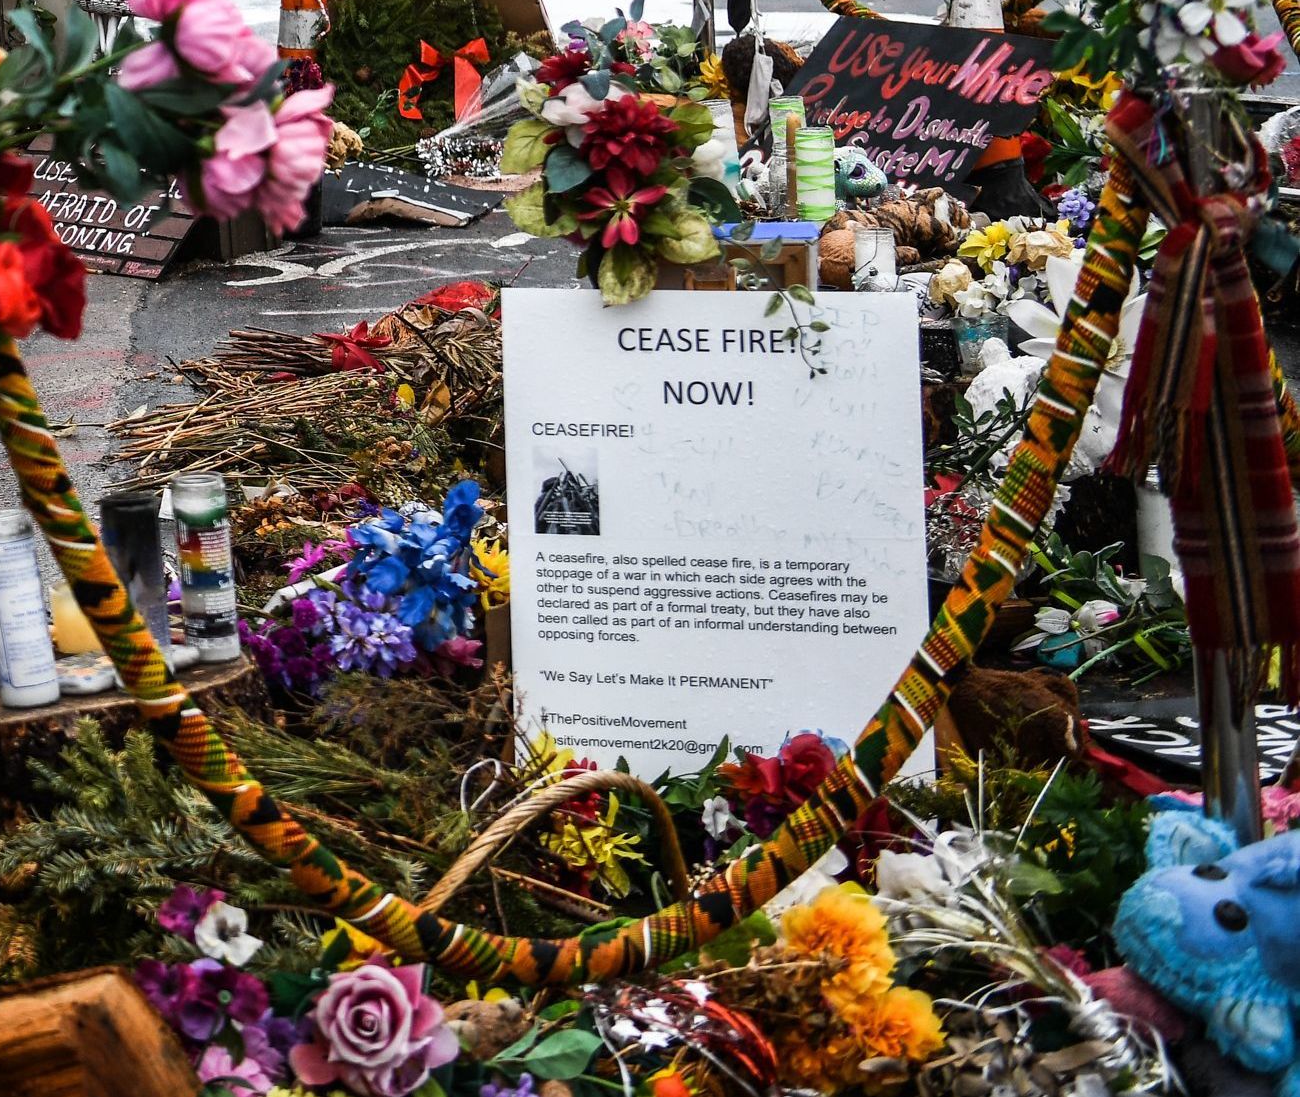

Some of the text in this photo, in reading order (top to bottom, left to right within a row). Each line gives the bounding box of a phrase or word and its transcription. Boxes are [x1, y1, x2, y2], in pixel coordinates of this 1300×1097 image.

[37, 189, 118, 225] AFRAID
[124, 205, 161, 230] OF
[617, 327, 797, 354] CEASE FIRE!
[662, 380, 755, 406] NOW!
[531, 422, 635, 439] CEASEFIRE!
[534, 550, 851, 575] A ceasefire, also spelled cease fire, is a temporary
[535, 567, 868, 589] stoppage of a war in which each side agrees with the
[535, 582, 889, 607] other to suspend aggressive actions. Ceasefires may be
[536, 596, 871, 620] declared as part of a formal treaty, but they have also
[537, 611, 898, 637] been called as part of an informal understanding between
[537, 628, 640, 644] opposing forces.
[568, 670, 594, 686] Say
[595, 671, 627, 685] Let's
[629, 673, 665, 687] Make
[667, 674, 677, 688] It
[540, 711, 688, 730] #ThePositiveMovement
